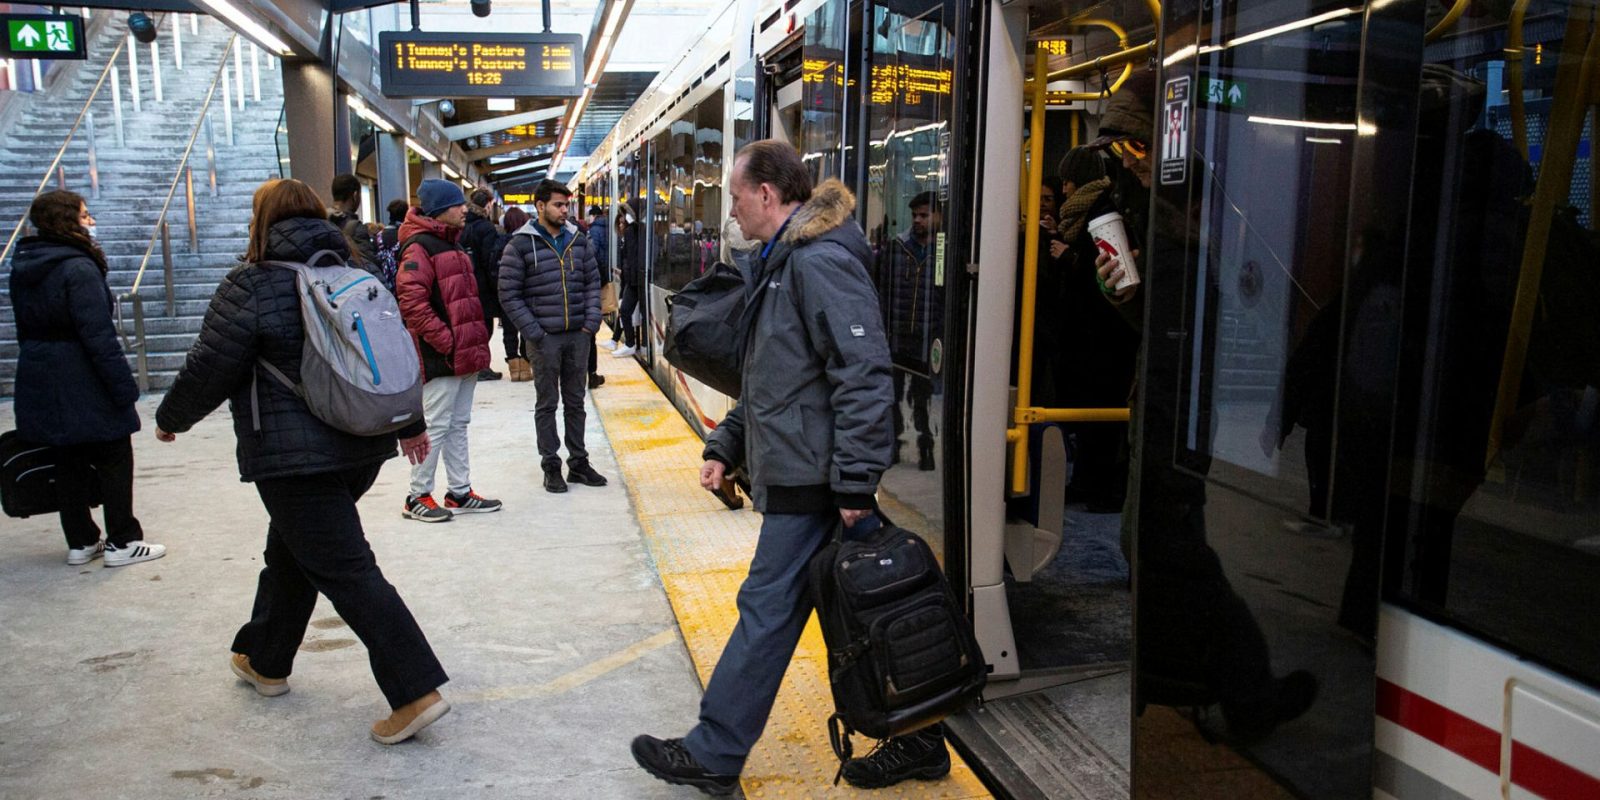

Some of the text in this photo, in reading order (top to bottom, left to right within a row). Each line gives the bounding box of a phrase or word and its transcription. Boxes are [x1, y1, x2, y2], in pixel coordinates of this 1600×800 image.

[395, 43, 571, 56] 1 Tunney's Pasture 2 min
[398, 57, 403, 69] 1
[408, 57, 468, 71] Tunney's
[474, 57, 526, 69] Pasture
[467, 72, 502, 84] 16:26
